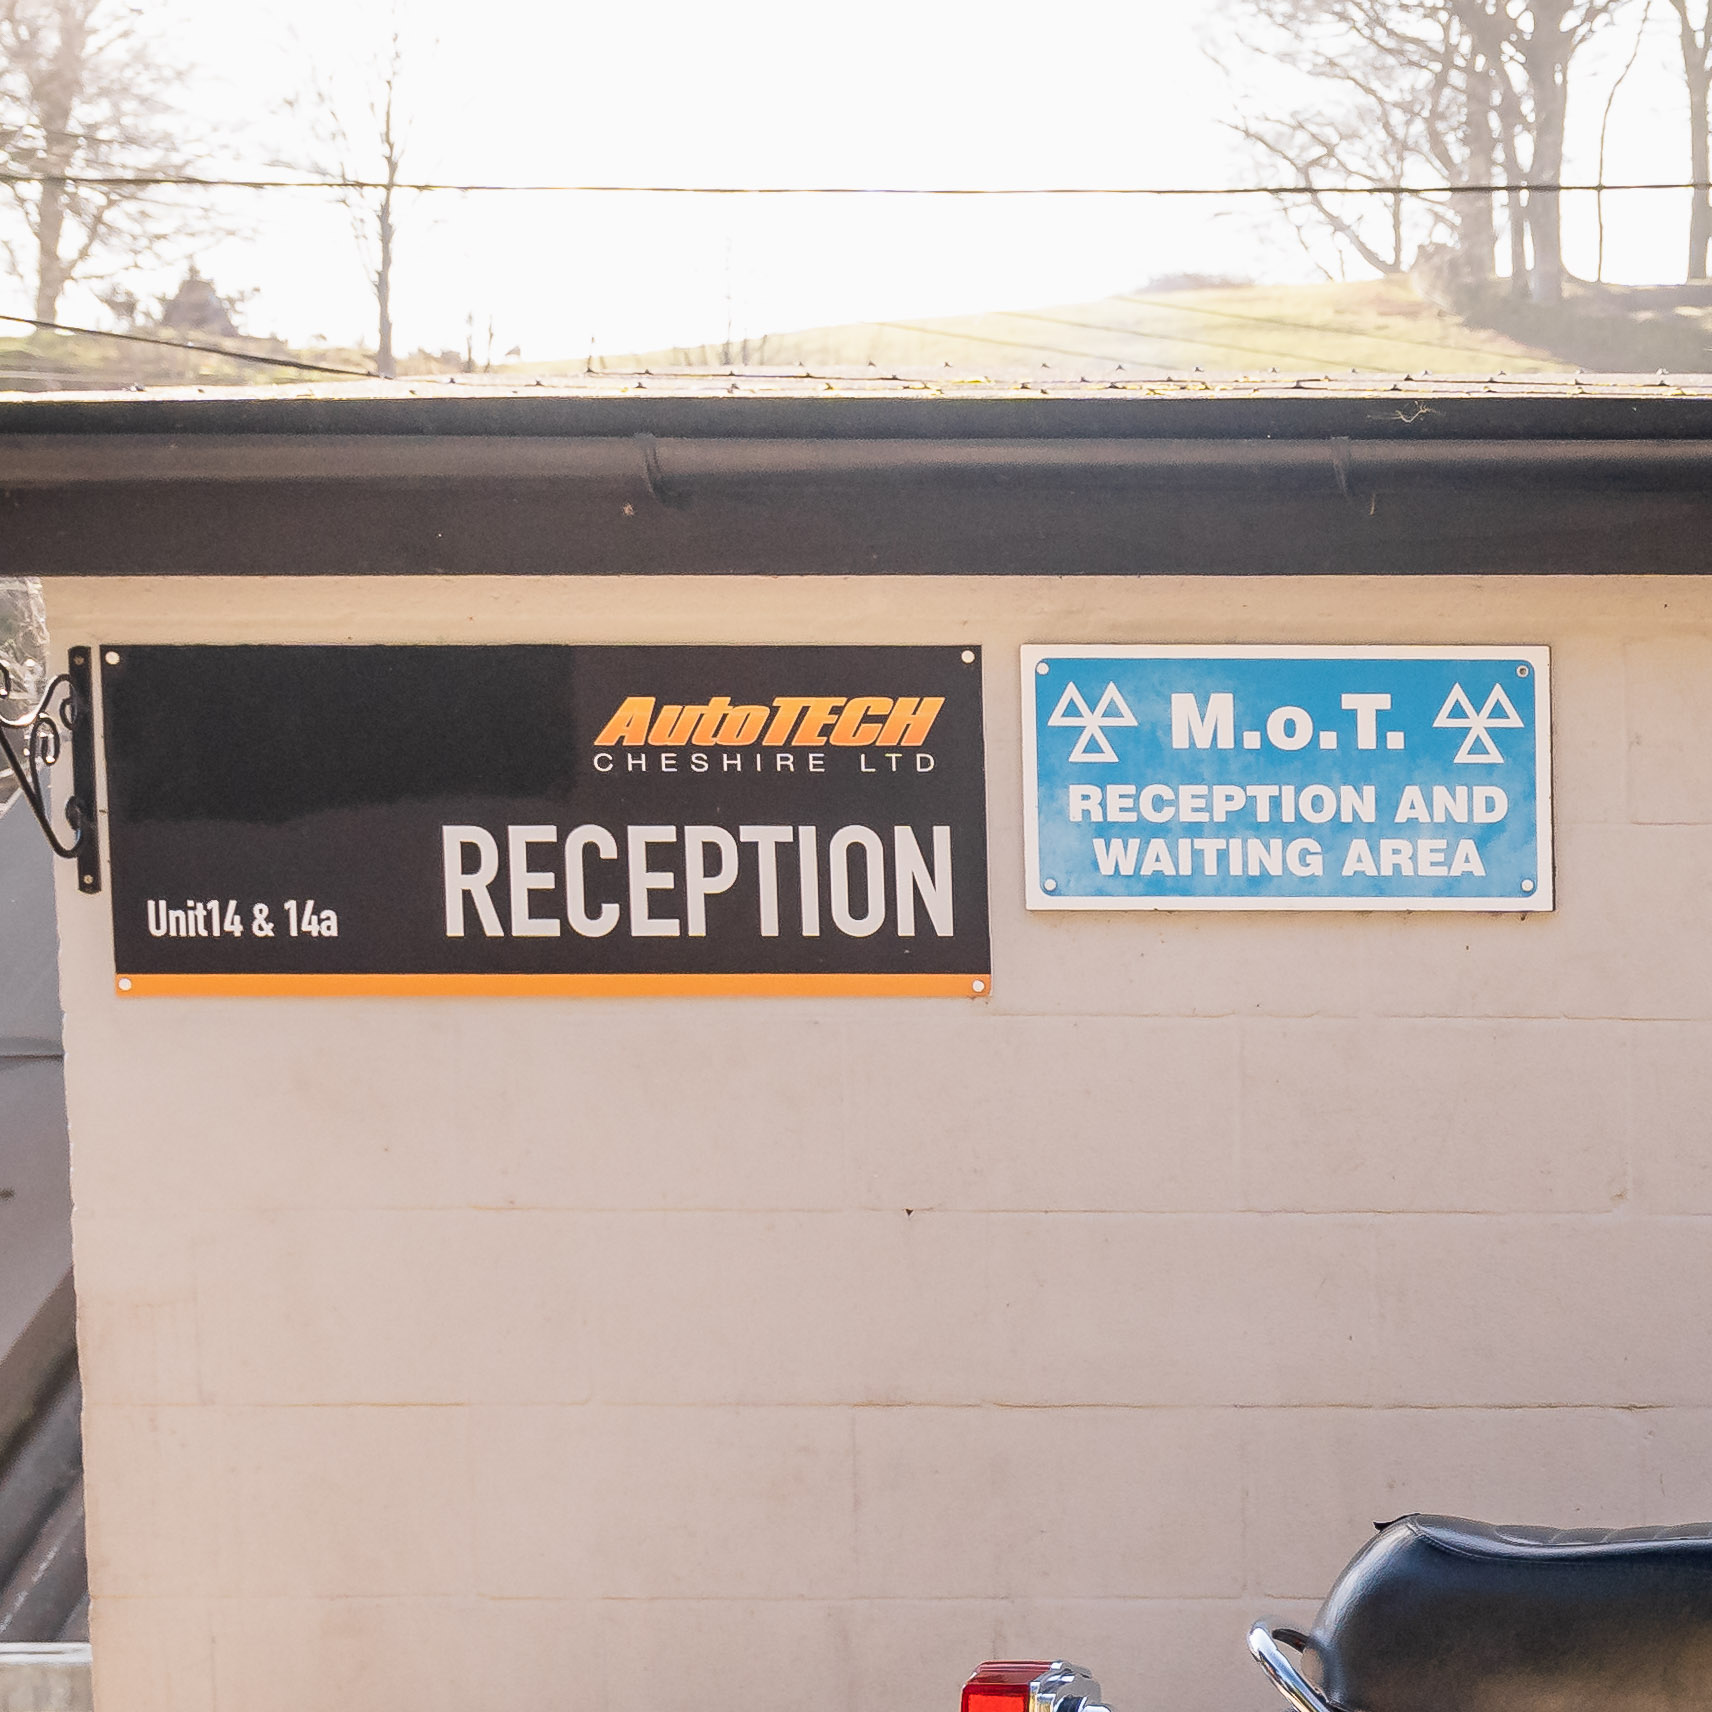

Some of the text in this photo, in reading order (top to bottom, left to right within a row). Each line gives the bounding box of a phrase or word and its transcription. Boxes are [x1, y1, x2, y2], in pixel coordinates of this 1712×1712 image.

[594, 696, 946, 747] AutoTECH
[1171, 692, 1405, 750] M.o.T.
[594, 753, 937, 773] CHESHIRE LTD
[1069, 784, 1508, 823] RECEPTION AND
[1093, 838, 1486, 877] WAITING AREA
[442, 824, 955, 939] RECEPTION
[148, 898, 338, 939] Unit14 & 14a
